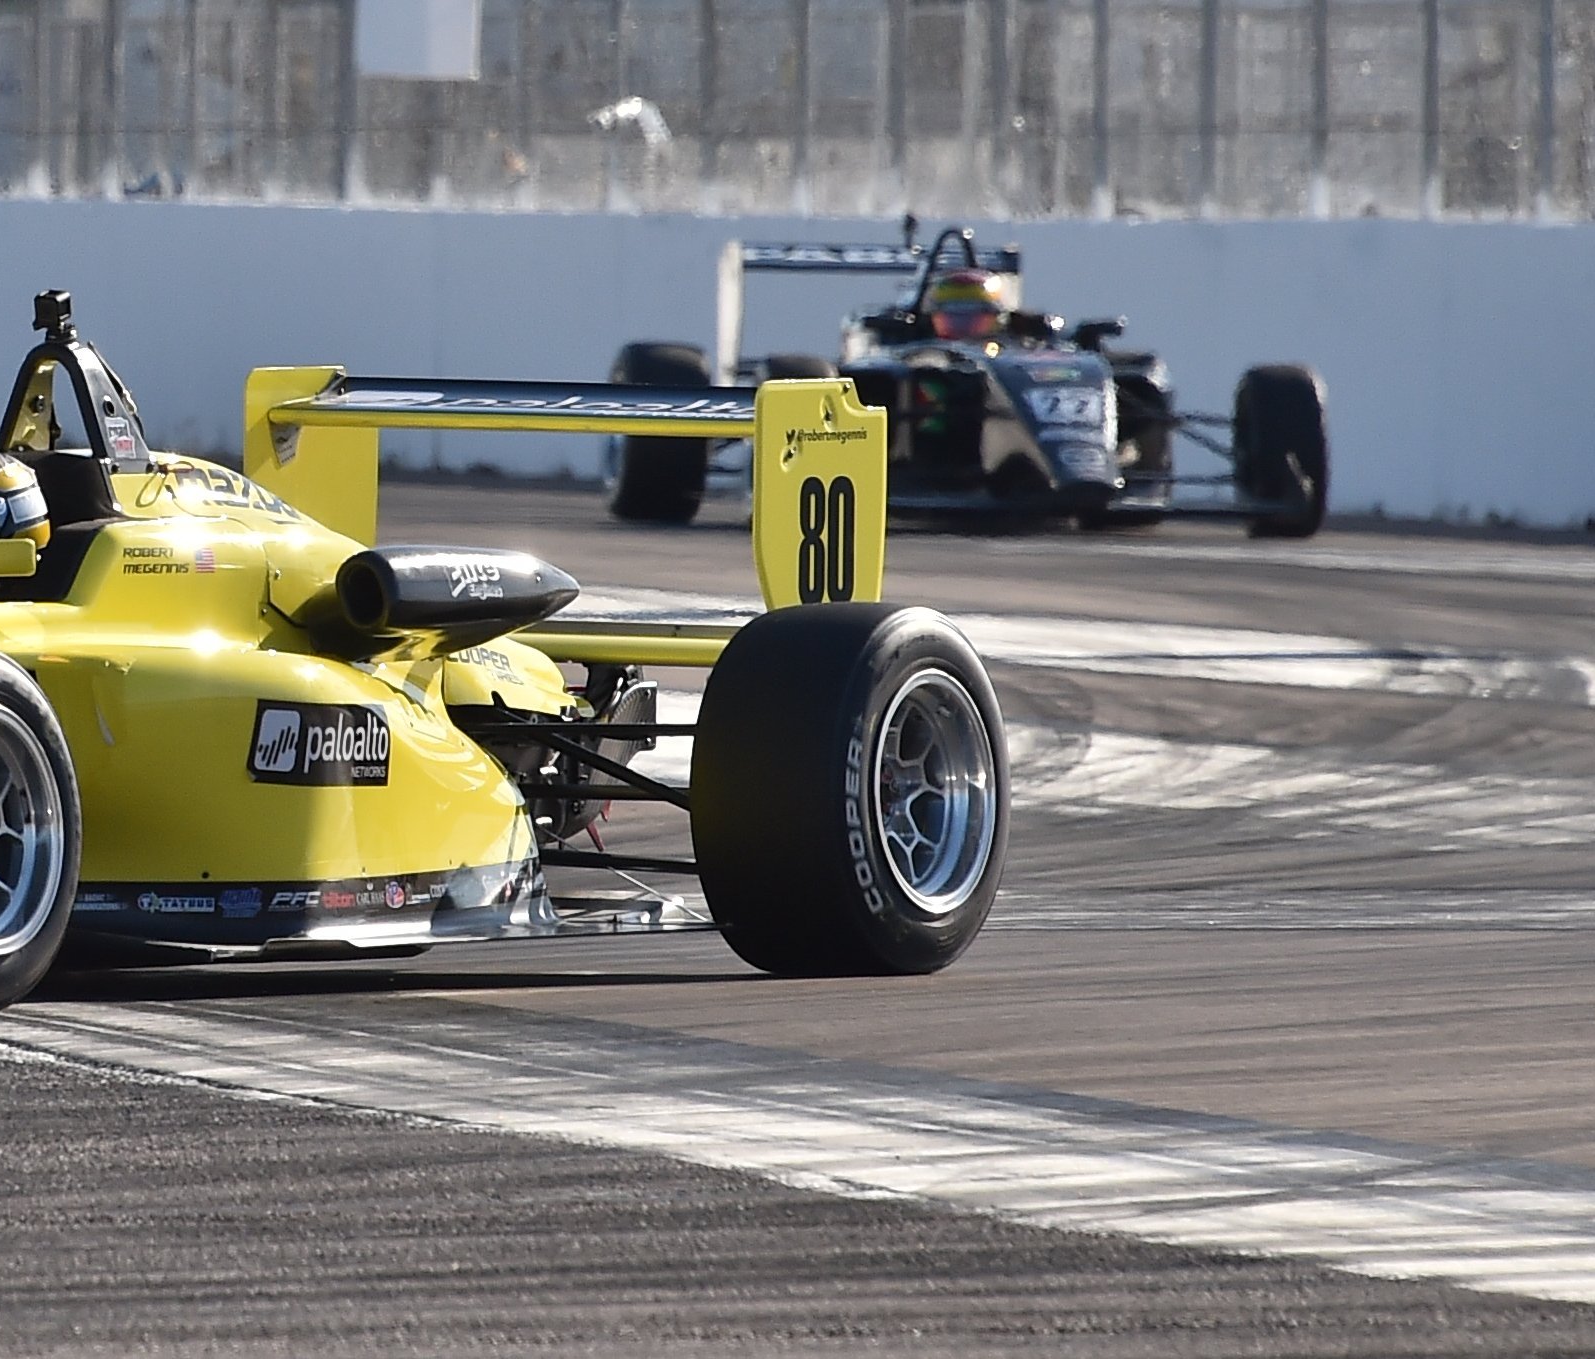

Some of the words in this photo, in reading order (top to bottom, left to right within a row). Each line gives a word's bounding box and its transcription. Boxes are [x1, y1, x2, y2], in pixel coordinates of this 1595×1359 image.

[797, 427, 867, 444] @robertmegennis
[799, 476, 854, 604] 80
[123, 547, 174, 558] ROBERT
[123, 563, 189, 574] MEGENNIS
[304, 712, 389, 774] paloalto
[351, 766, 386, 778] NETWORKS
[845, 736, 884, 914] COOPER
[271, 892, 321, 904] PFC
